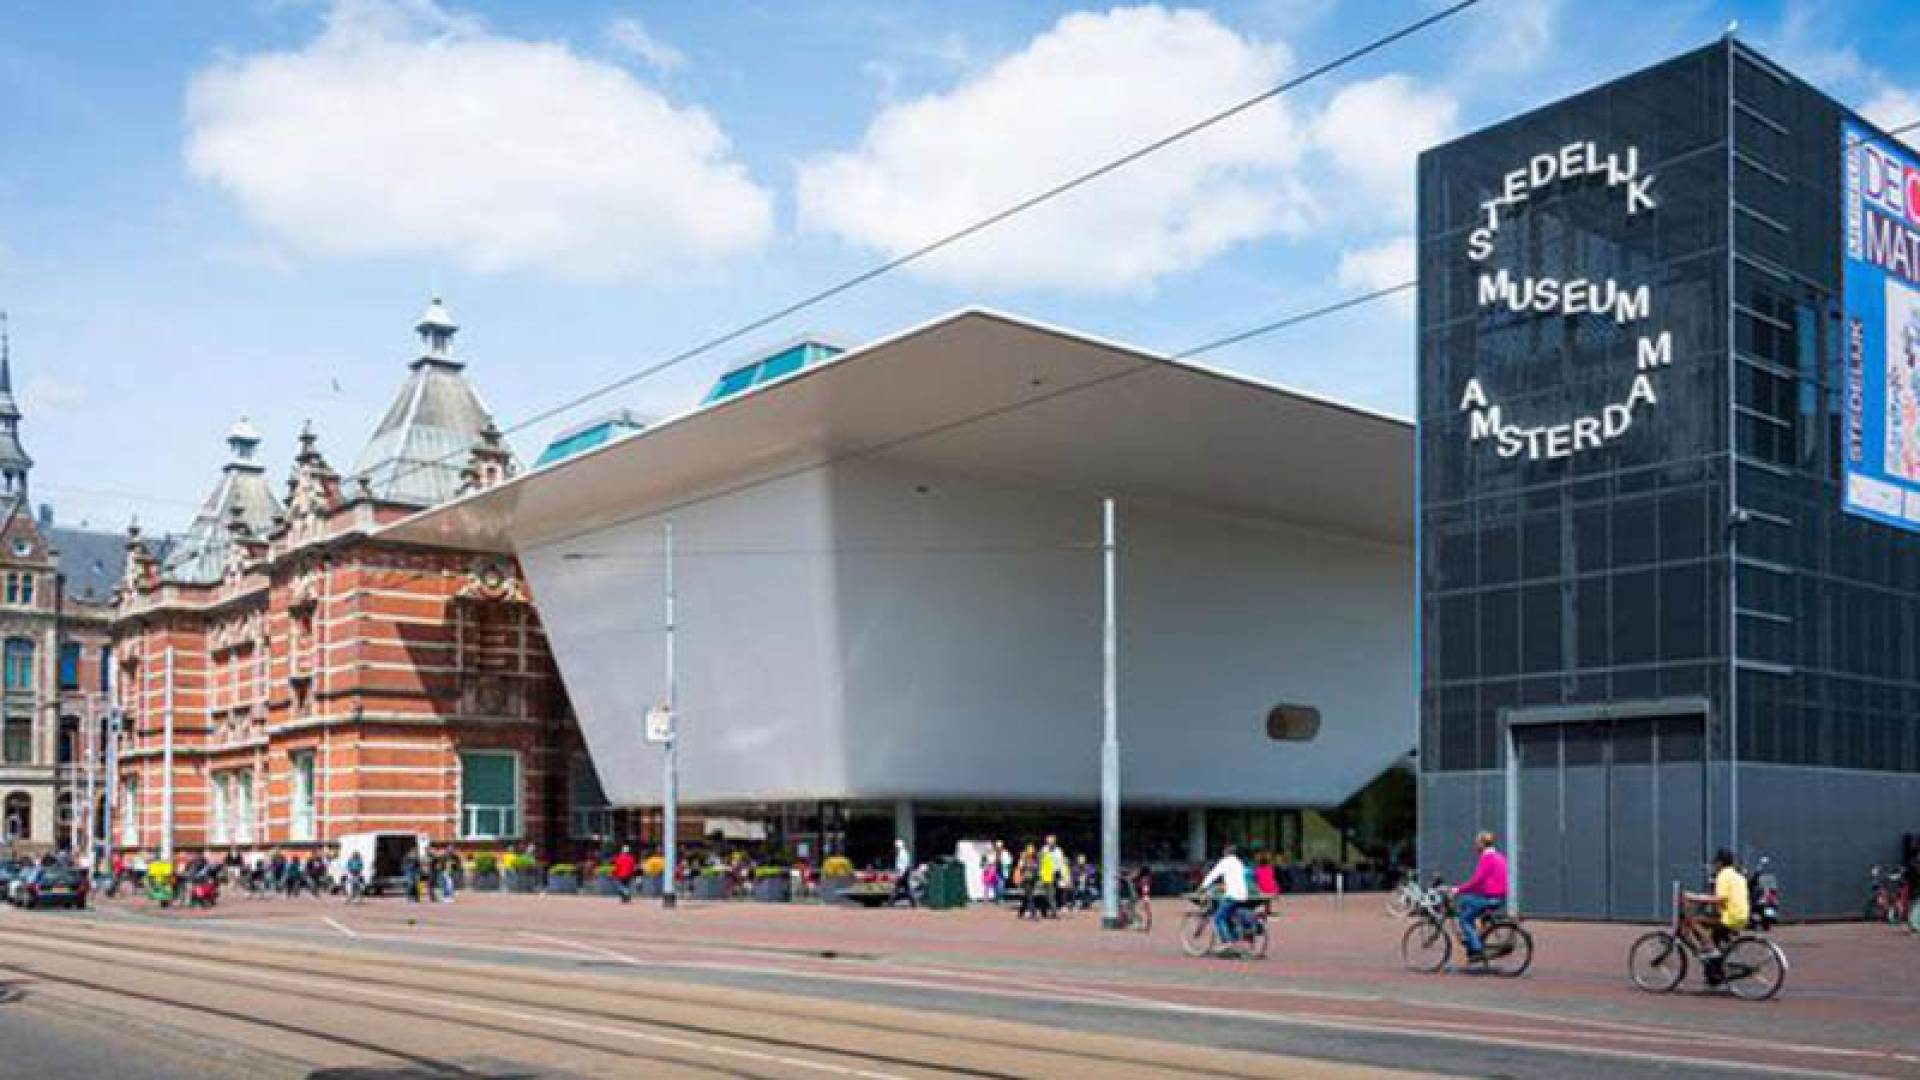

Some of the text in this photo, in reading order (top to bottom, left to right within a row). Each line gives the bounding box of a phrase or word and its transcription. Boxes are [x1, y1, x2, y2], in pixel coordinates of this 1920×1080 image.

[1467, 140, 1657, 260] STEDELIJK
[1478, 268, 1650, 324] MUSEUM
[1460, 330, 1672, 460] AMSTERDAM
